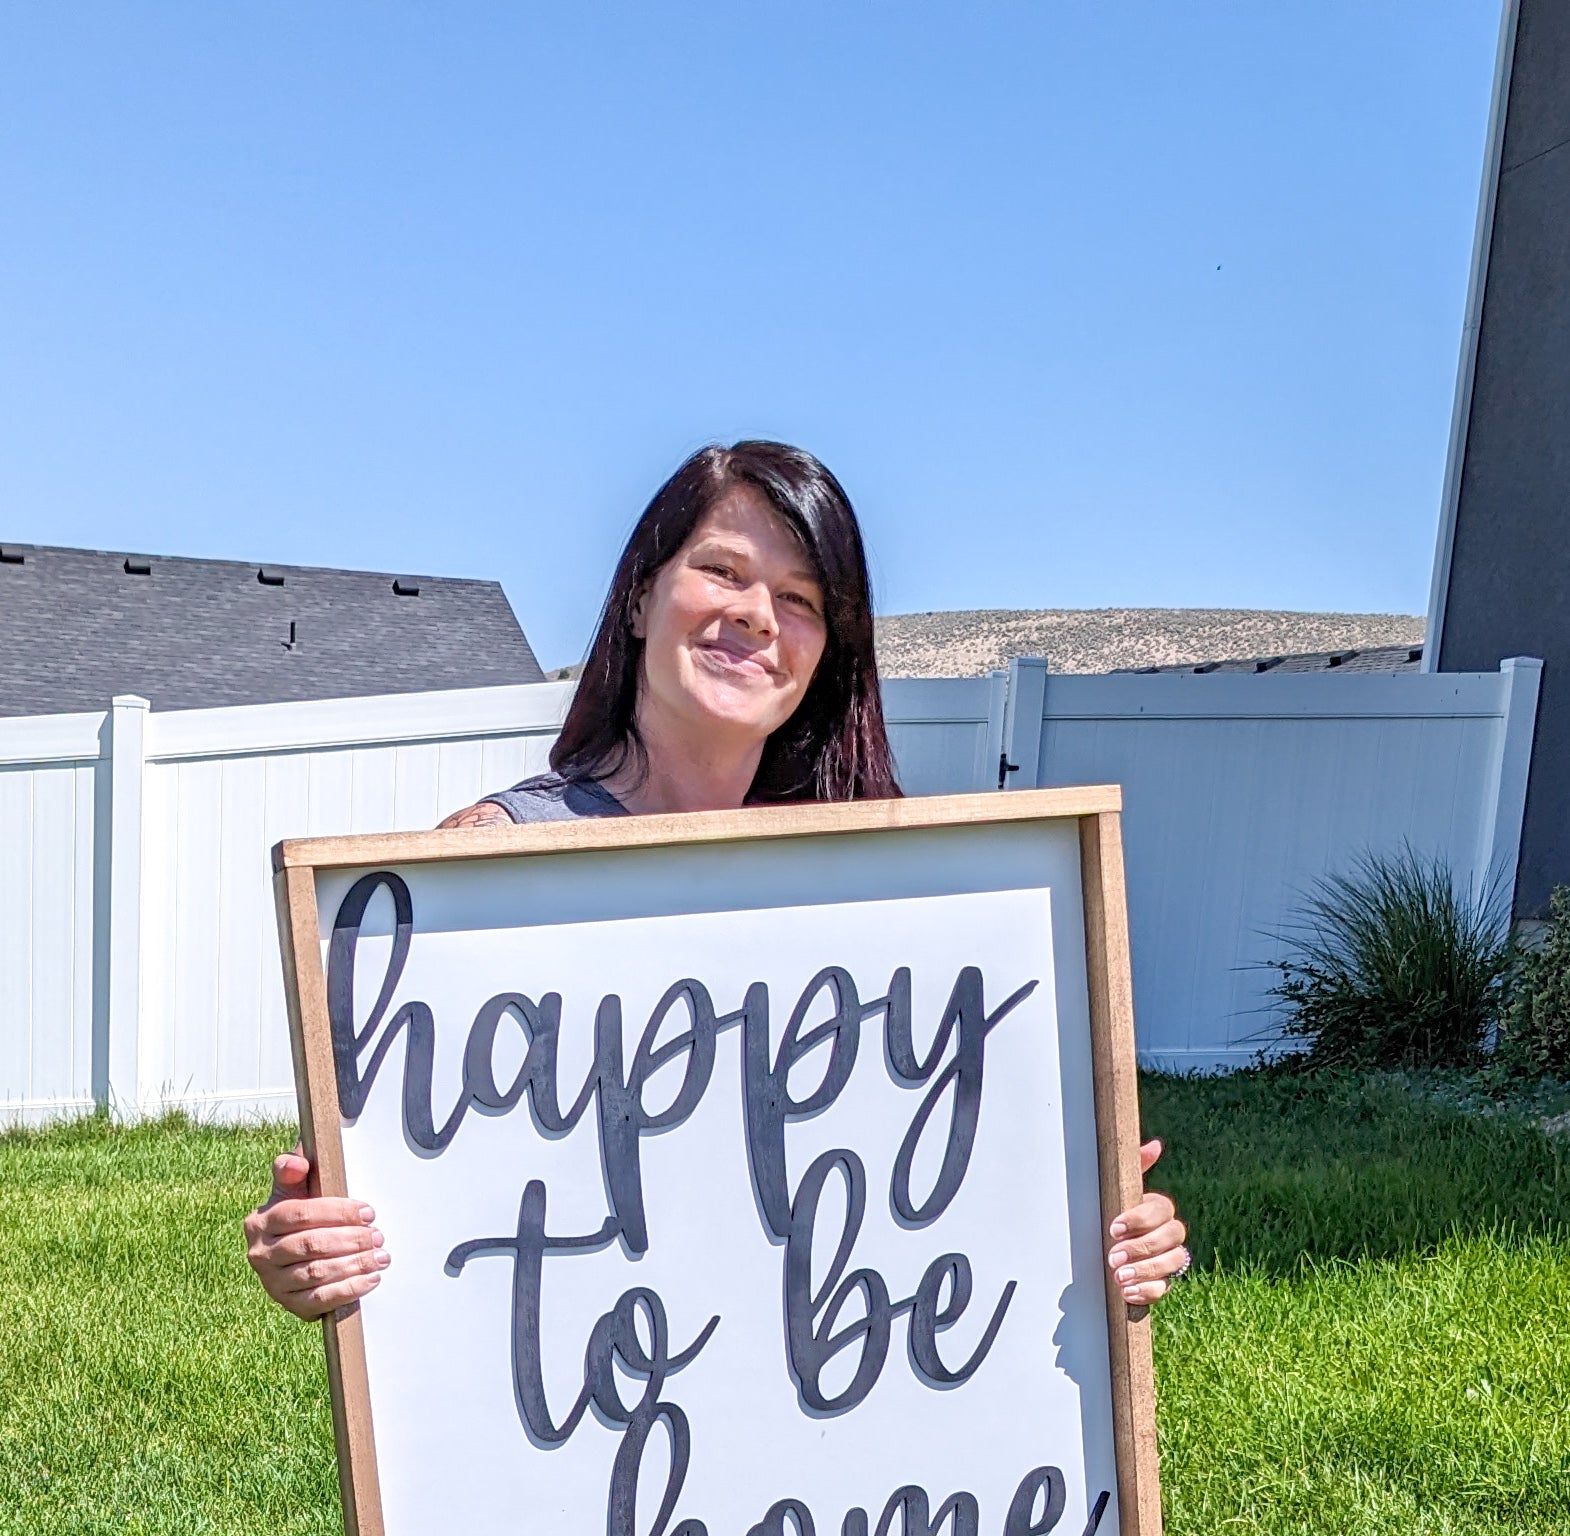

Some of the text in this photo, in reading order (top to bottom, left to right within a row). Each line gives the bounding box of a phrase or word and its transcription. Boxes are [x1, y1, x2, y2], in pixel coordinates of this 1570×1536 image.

[329, 871, 1039, 1252] happy
[446, 1148, 1017, 1444] to be
